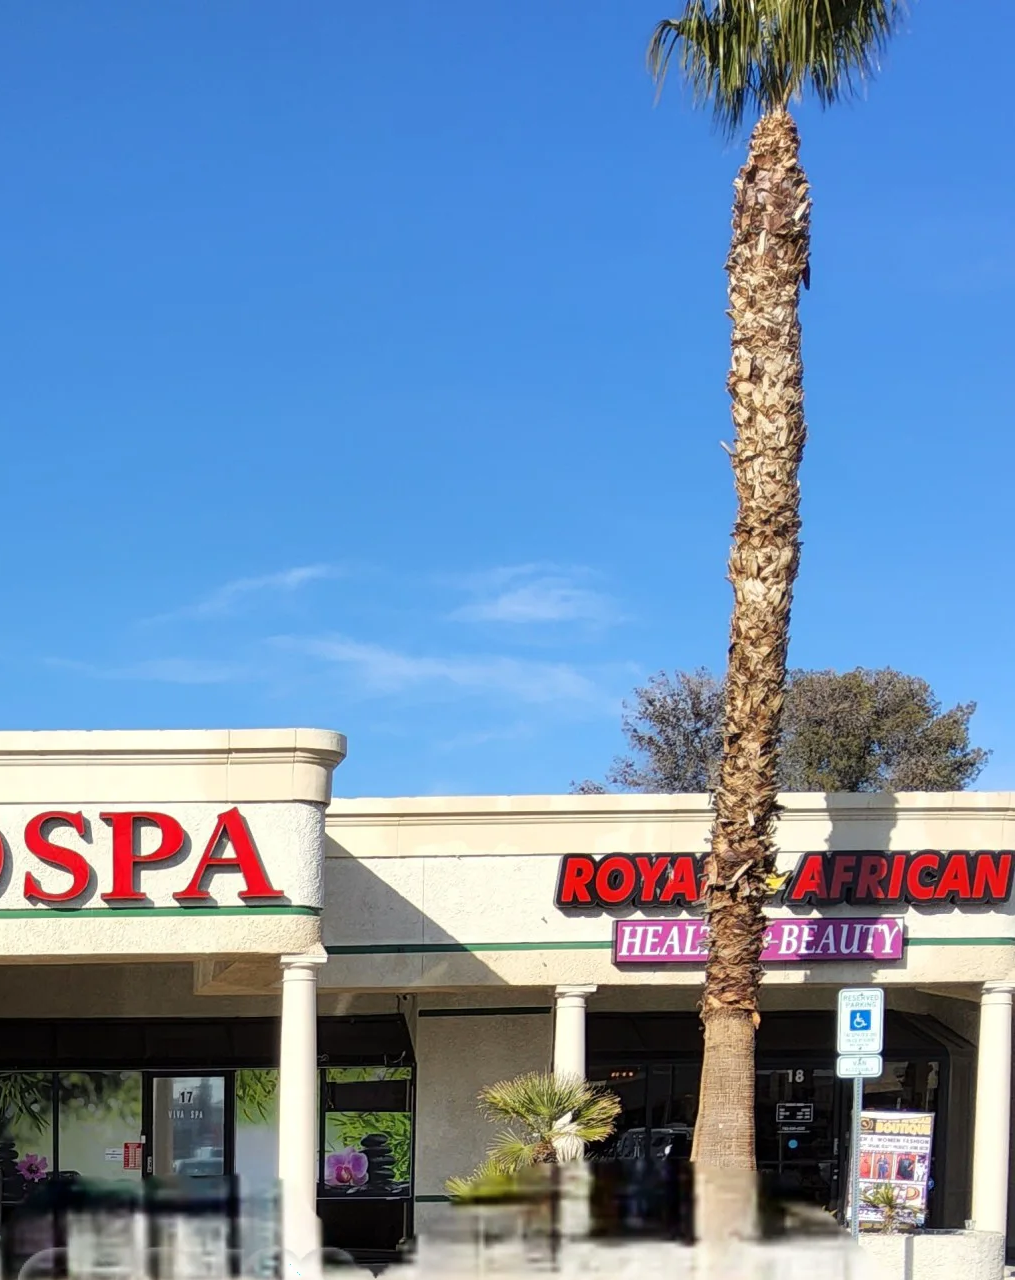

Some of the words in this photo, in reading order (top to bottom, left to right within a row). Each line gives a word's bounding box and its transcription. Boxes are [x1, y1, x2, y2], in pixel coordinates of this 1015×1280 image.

[24, 806, 284, 901] SPA
[561, 856, 711, 902] ROYA
[791, 854, 1012, 900] AFRICAN
[618, 925, 712, 956] HEAL
[778, 923, 899, 955] BEAUTY
[843, 994, 879, 1002] RESERVED
[787, 1069, 805, 1083] 18
[179, 1091, 194, 1103] 17
[168, 1110, 185, 1119] VIVA
[190, 1110, 203, 1119] SPA
[875, 1121, 931, 1135] BOUTIQUE
